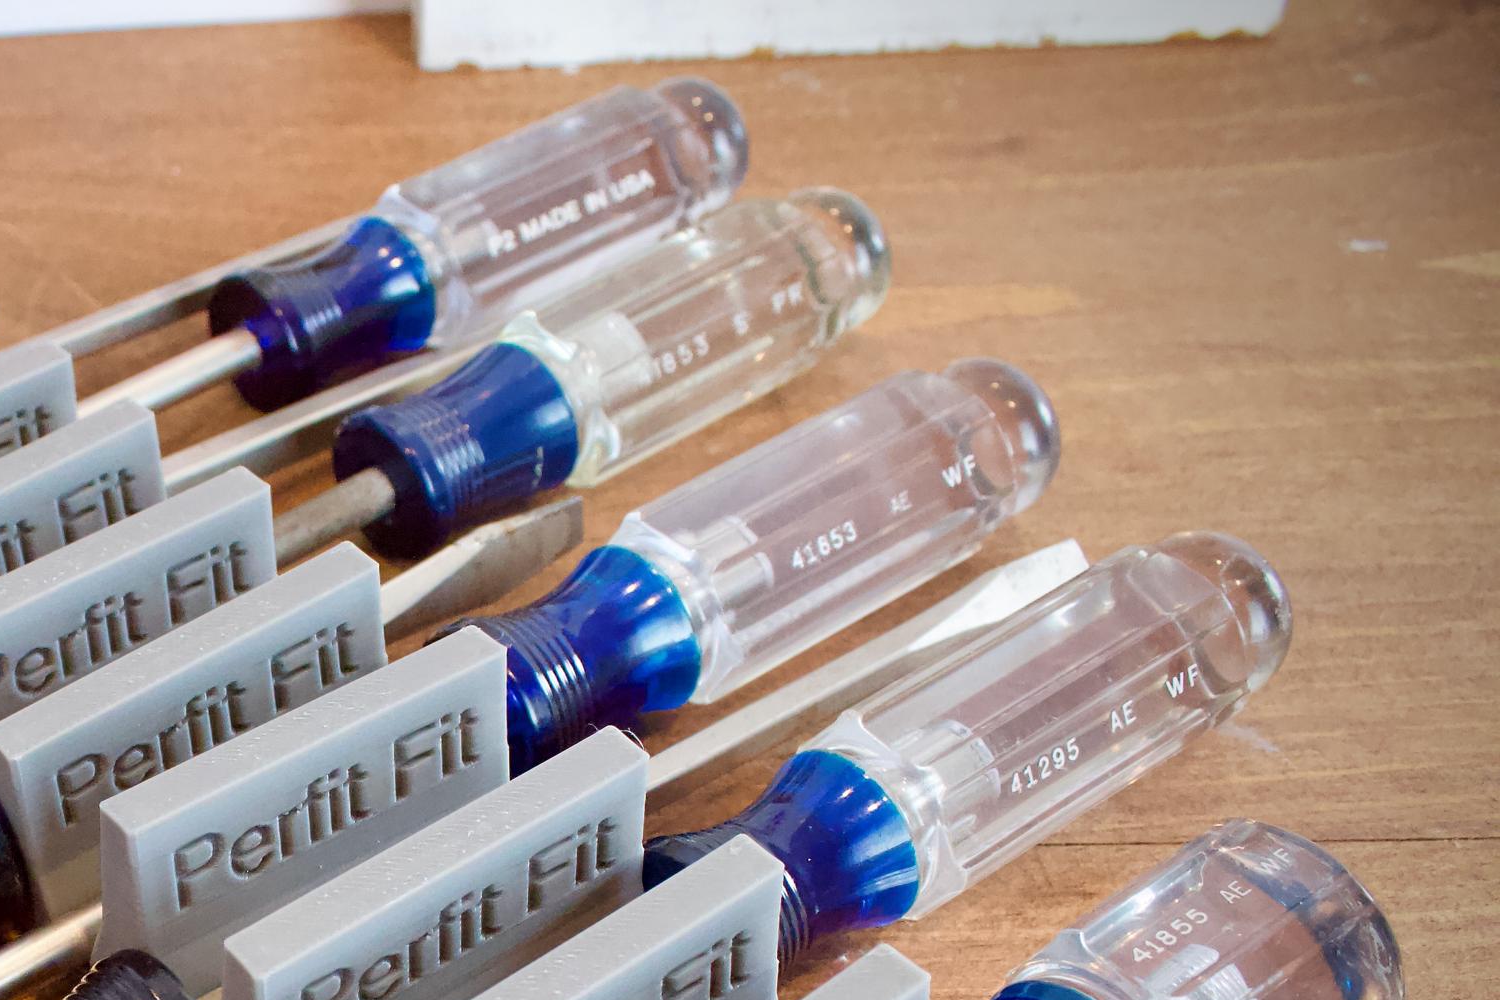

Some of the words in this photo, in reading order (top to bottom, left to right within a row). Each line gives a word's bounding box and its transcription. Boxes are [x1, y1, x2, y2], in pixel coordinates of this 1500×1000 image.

[518, 199, 582, 243] MADE
[583, 188, 609, 214] IN
[54, 467, 135, 546] Fit
[792, 519, 857, 569] 41853
[941, 454, 976, 488] WF
[164, 540, 252, 628] Fit
[54, 680, 249, 828] Perfit
[268, 622, 357, 715] Fit
[1011, 736, 1080, 794] 41295
[1110, 700, 1137, 734] AE
[1165, 663, 1199, 699] WF
[172, 762, 374, 912] Perfit
[393, 707, 480, 803] Fit
[525, 816, 617, 915] Fit
[1130, 907, 1209, 965] 41855
[1219, 880, 1252, 904] AE
[1258, 847, 1292, 876] WF
